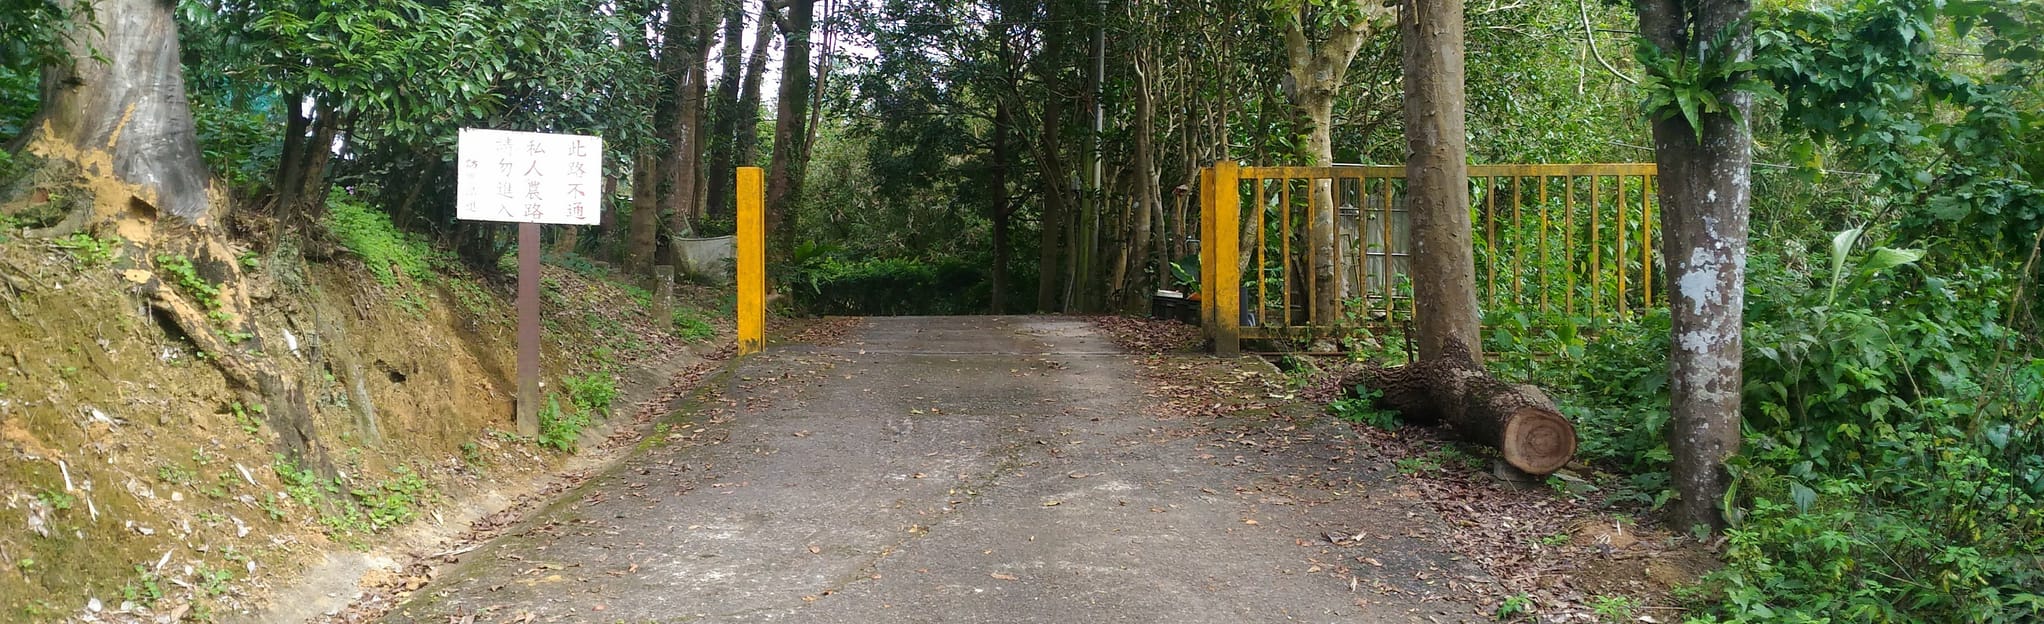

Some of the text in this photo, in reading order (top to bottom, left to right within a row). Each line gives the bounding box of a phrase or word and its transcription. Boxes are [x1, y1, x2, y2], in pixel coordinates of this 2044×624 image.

[523, 139, 546, 220] 私人農路
[566, 139, 588, 221] 此路不通
